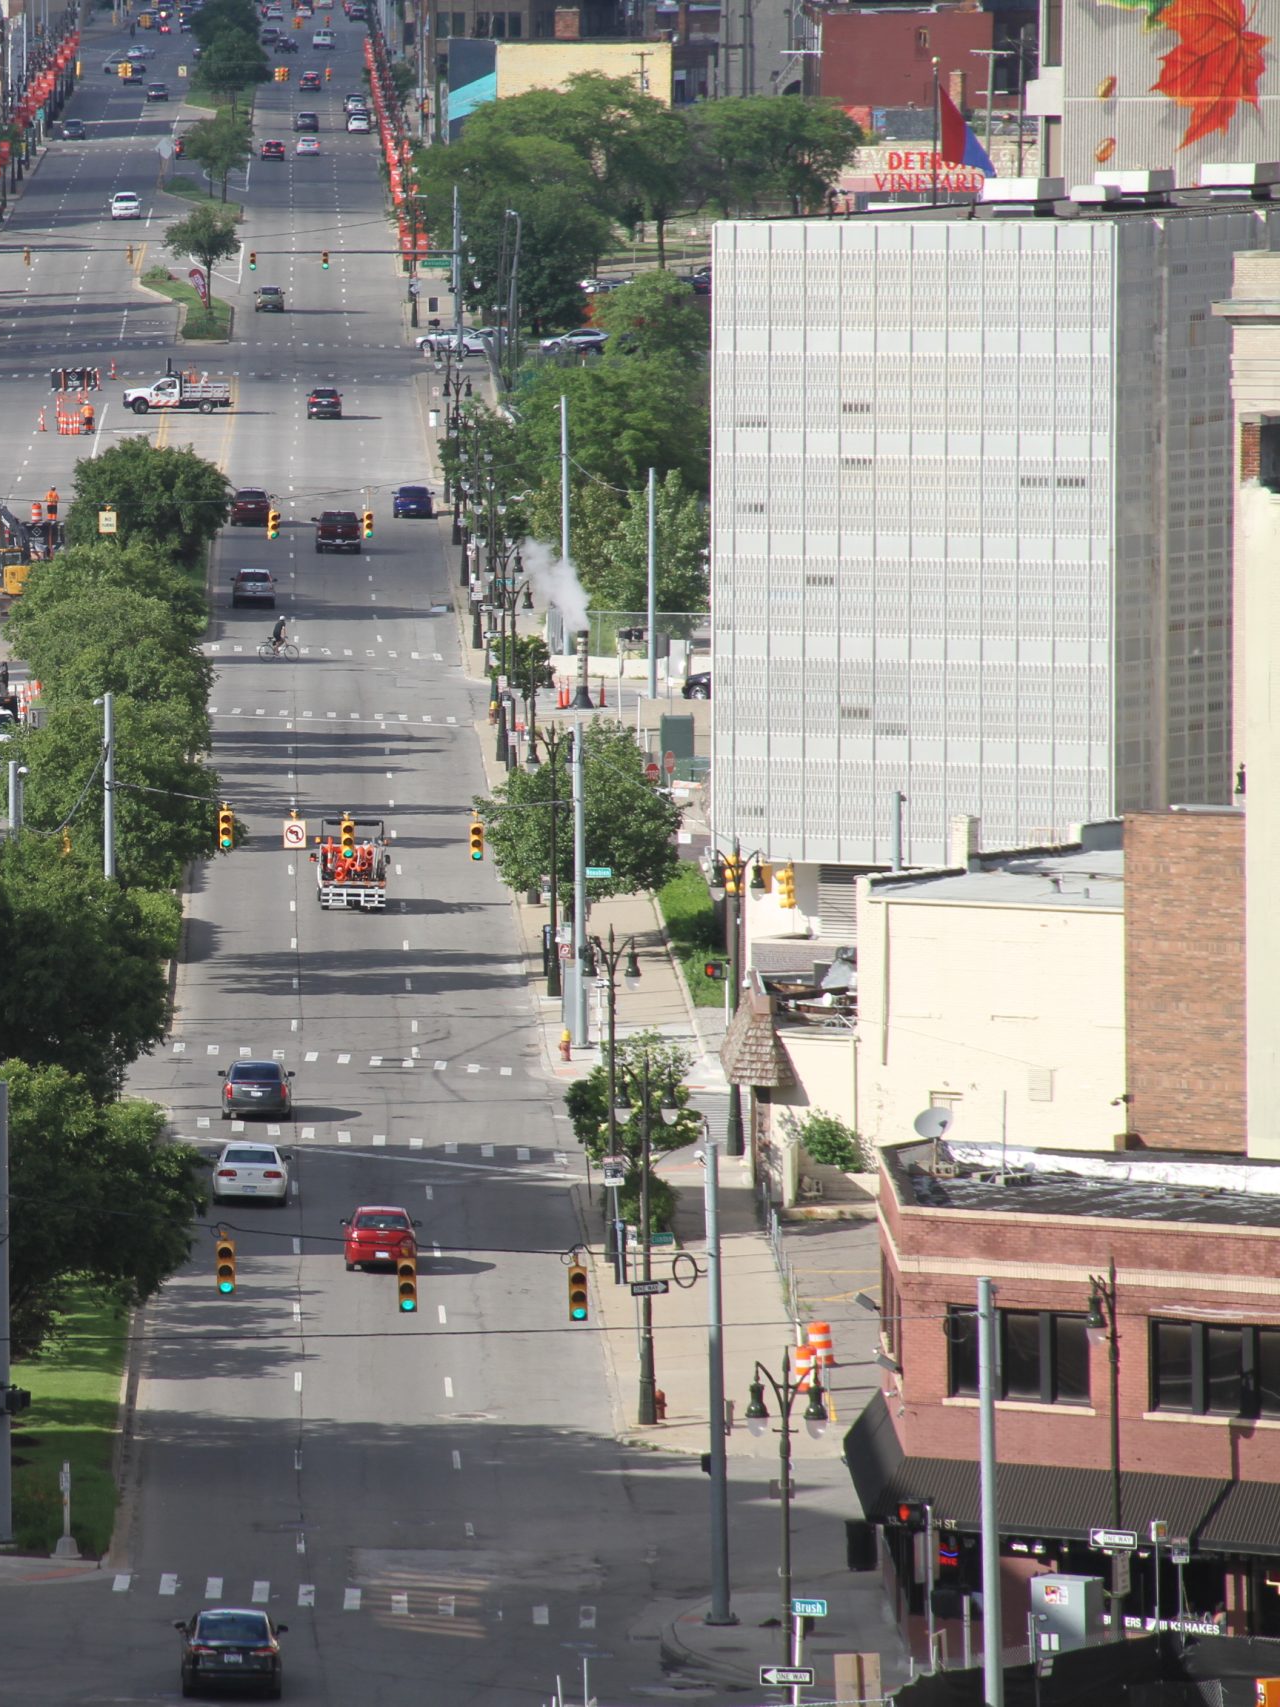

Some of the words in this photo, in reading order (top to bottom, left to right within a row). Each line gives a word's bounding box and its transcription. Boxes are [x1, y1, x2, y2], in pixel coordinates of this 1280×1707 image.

[795, 1602, 822, 1612] Brush
[776, 1672, 790, 1680] ONE
[792, 1673, 807, 1681] WAY
